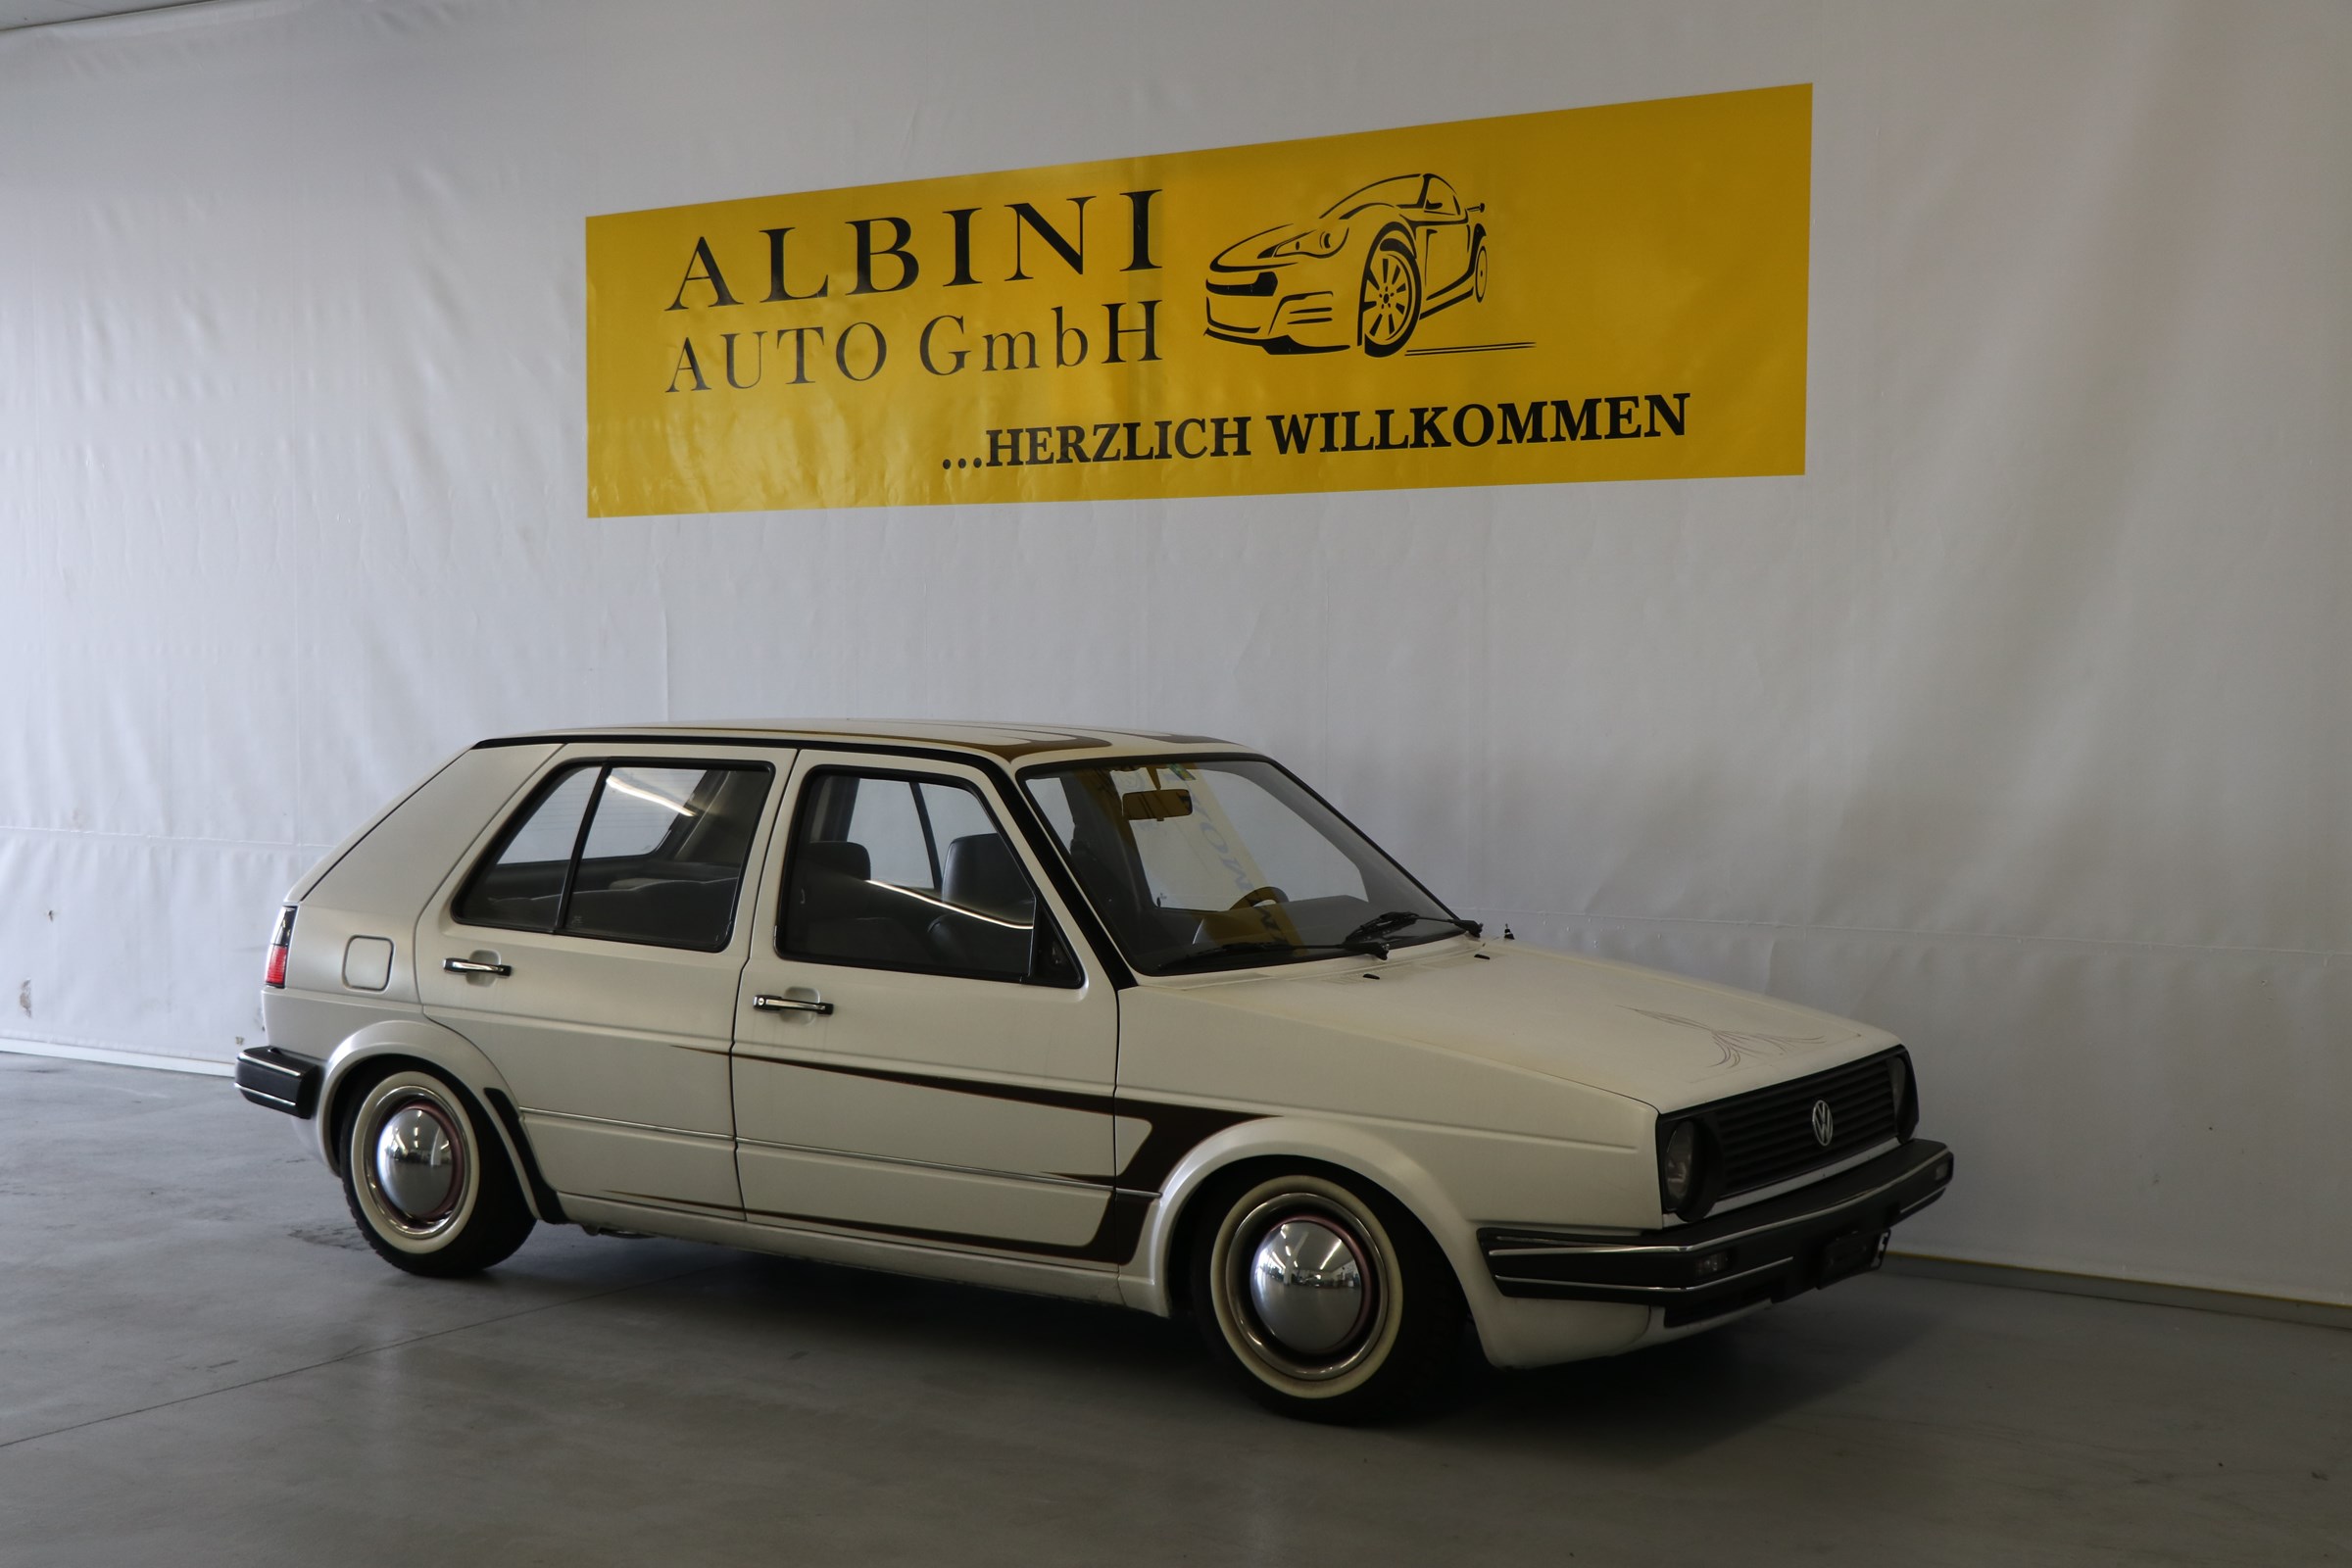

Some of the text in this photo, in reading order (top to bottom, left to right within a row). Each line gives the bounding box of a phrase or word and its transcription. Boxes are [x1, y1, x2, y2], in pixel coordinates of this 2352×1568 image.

[664, 188, 1163, 311] ALBINI
[664, 299, 1163, 393] AUTO GmbH
[942, 392, 1691, 470] ...HERZLICH WILLKOMMEN
[1812, 1099, 1833, 1147] VW
